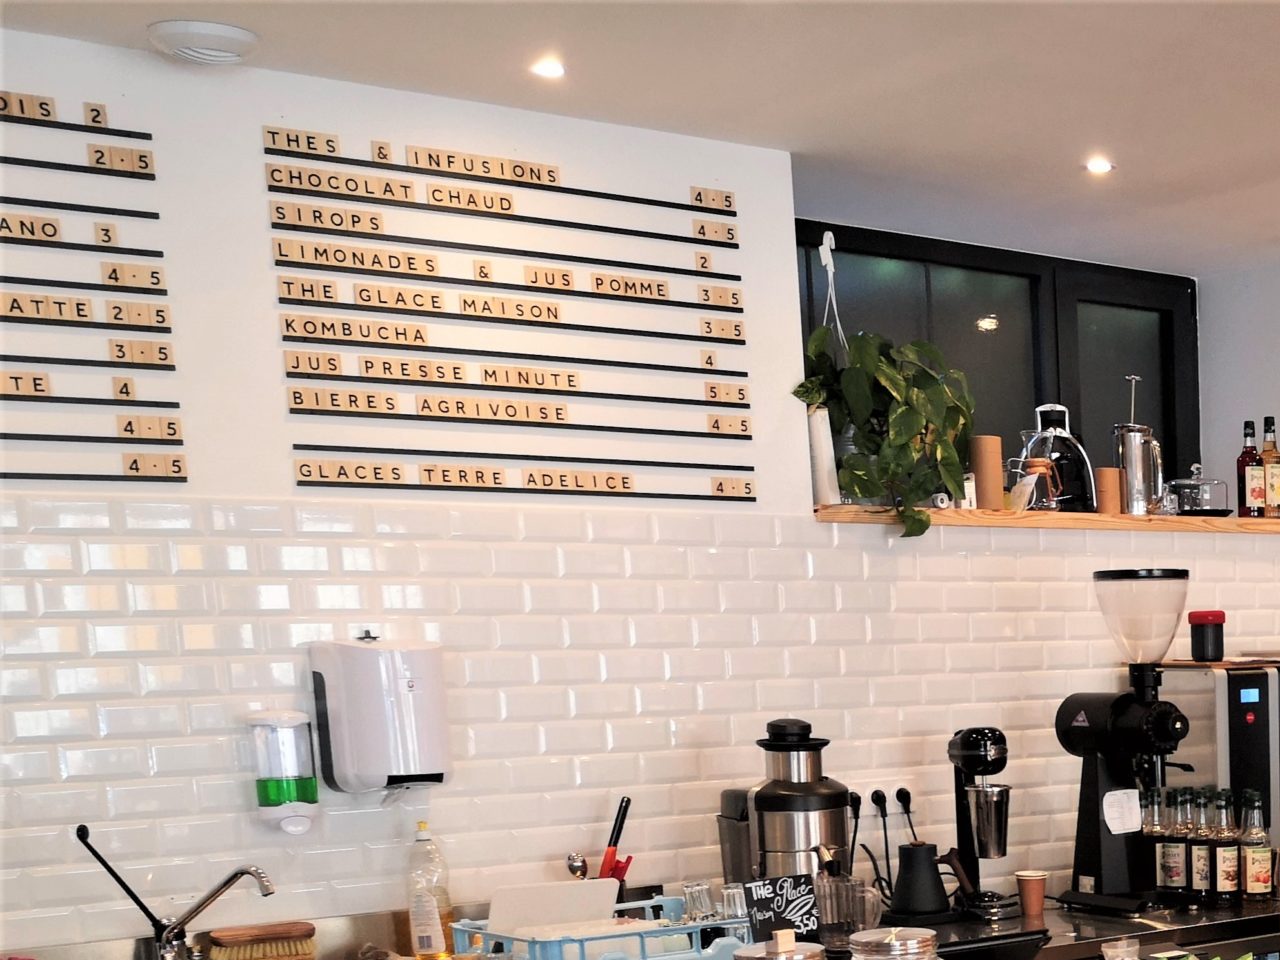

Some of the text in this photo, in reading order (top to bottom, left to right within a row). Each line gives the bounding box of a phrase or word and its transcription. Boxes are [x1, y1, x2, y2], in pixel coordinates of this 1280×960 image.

[90, 107, 102, 124] 2
[267, 130, 337, 154] THES
[378, 145, 389, 160] &
[414, 150, 557, 184] INFUSIONS
[270, 168, 412, 200] CHOCOLAT
[432, 188, 513, 212] CHAUD
[100, 228, 112, 243] 3
[274, 206, 709, 270] SIROPS 2
[278, 243, 437, 273] LIMONADES
[478, 266, 489, 280] &
[529, 271, 572, 288] JUS
[595, 277, 667, 298] POMME
[9, 298, 89, 318] ATTE
[282, 281, 334, 300] THE
[358, 289, 444, 310] GLACE
[462, 298, 559, 321] MAISON
[285, 318, 715, 368] KOMBUCHA 4
[9, 376, 130, 397] TE 4
[290, 355, 338, 372] JUS
[364, 360, 464, 380] PRESSE
[483, 369, 578, 389] MINUTE
[293, 391, 397, 411] BIERES
[420, 399, 567, 422] AGRIVOISE
[299, 463, 402, 482] GLACES
[424, 468, 503, 487] TERRE
[526, 474, 633, 491] ADELICE
